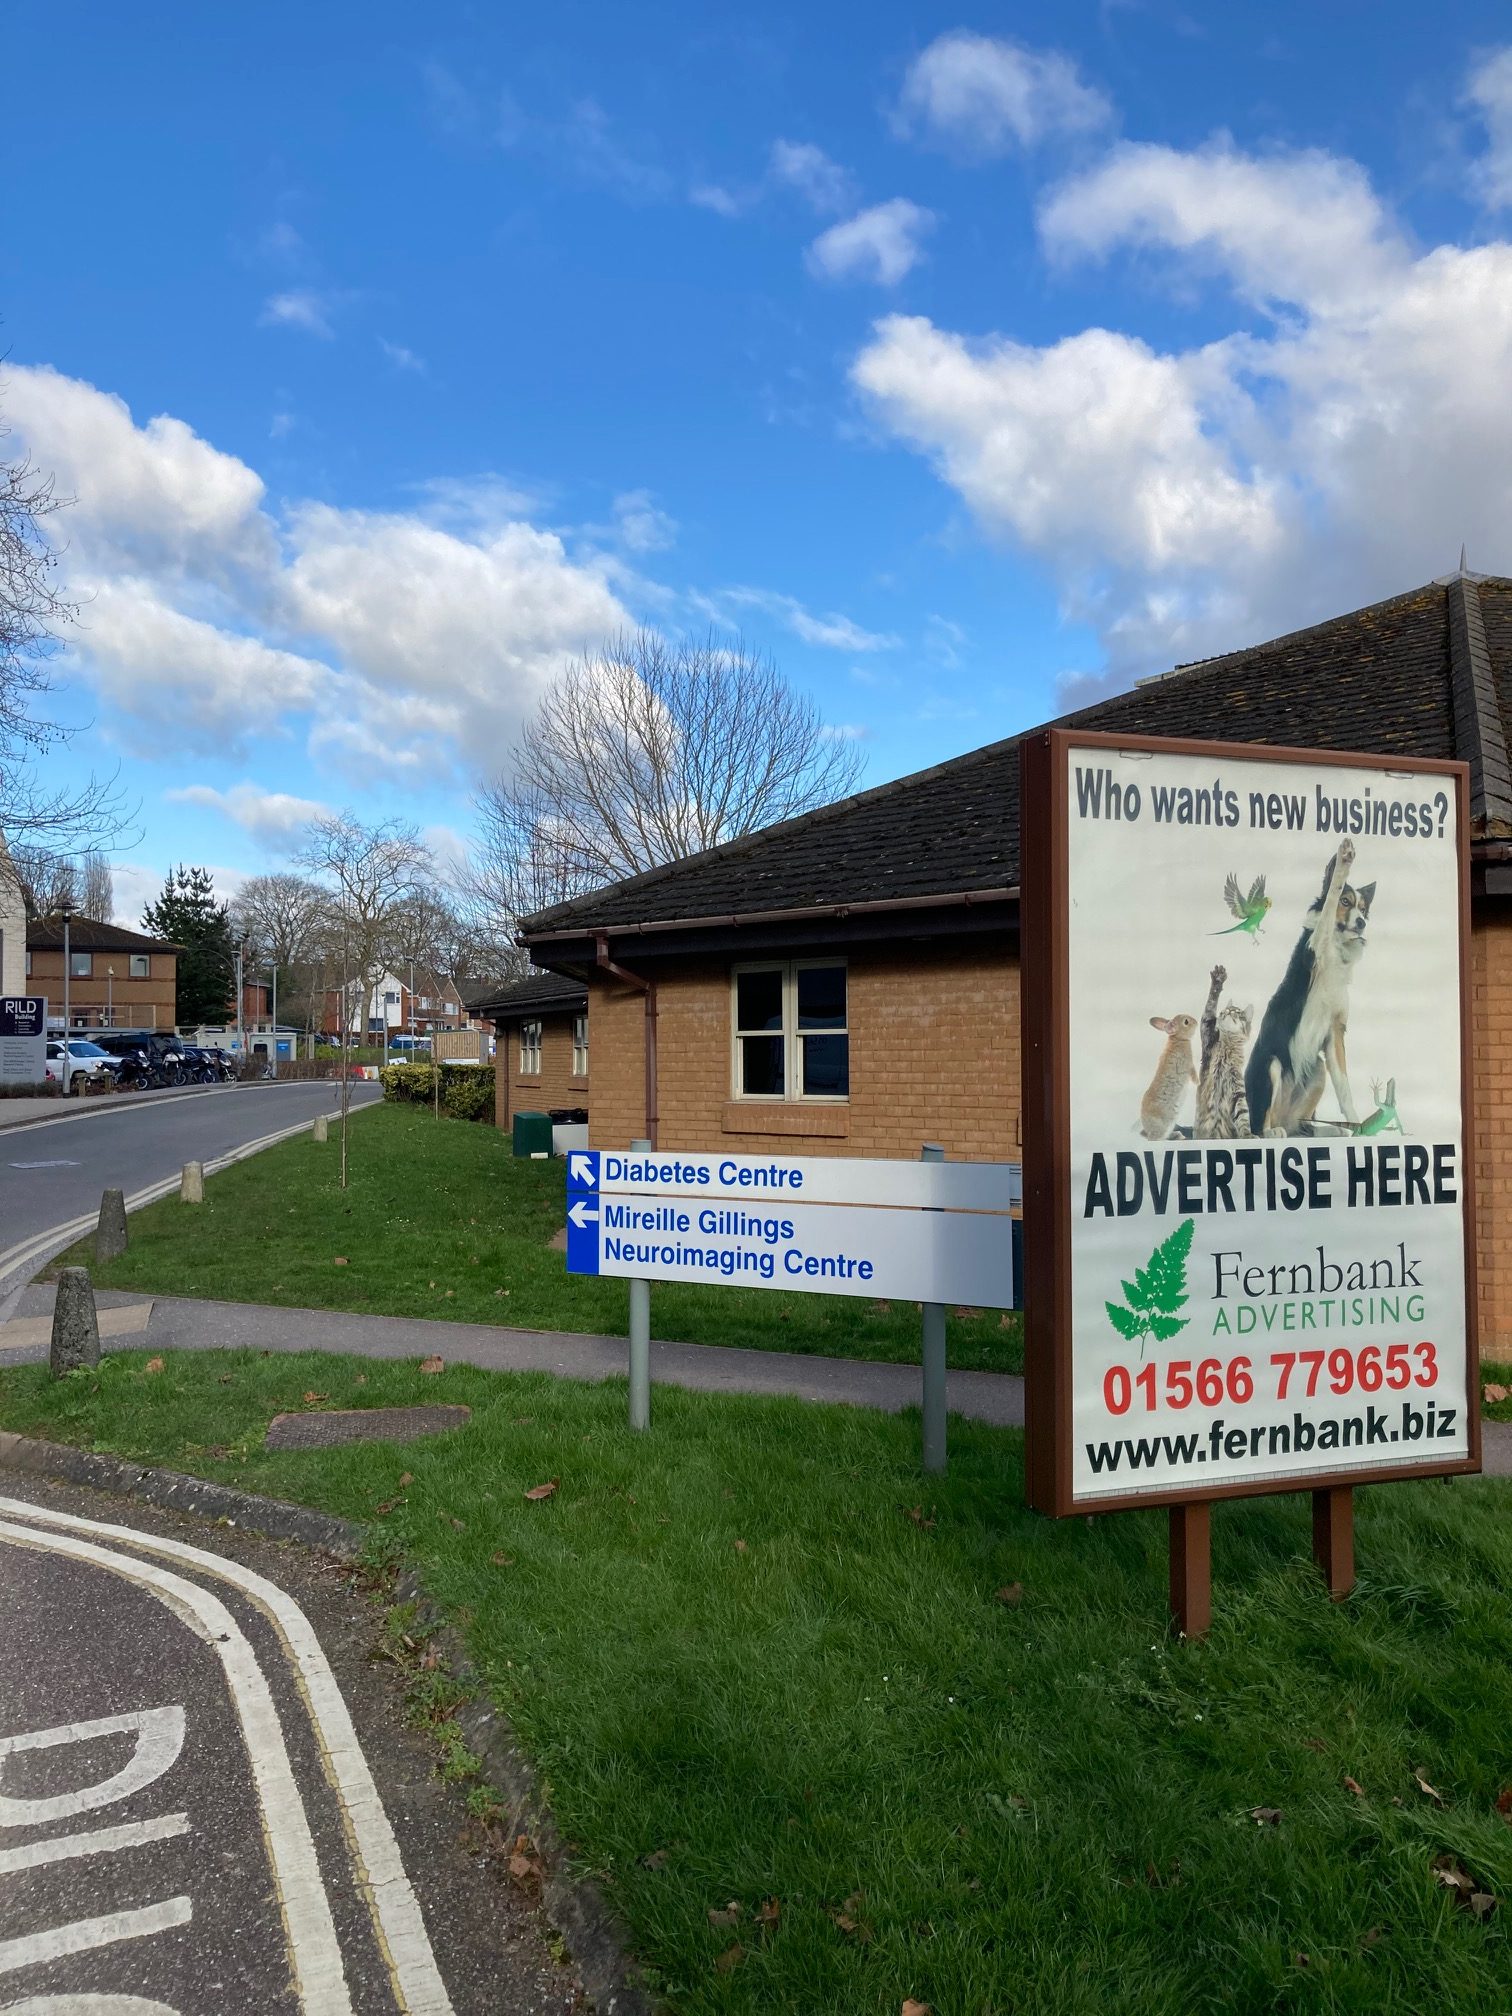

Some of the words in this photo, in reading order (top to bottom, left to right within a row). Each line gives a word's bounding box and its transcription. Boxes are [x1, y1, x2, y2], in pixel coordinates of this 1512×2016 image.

[1075, 767, 1142, 822] Who
[1150, 777, 1240, 828] wants
[1249, 792, 1307, 831] new
[1315, 784, 1449, 839] business?
[5, 1000, 37, 1014] RILD
[605, 1157, 711, 1185] Diabetes
[718, 1160, 804, 1189] Centre
[1083, 1146, 1332, 1219] ADVERTISE
[1346, 1143, 1458, 1208] HERE
[604, 1204, 691, 1234] Mireille
[698, 1209, 795, 1245] Gillings
[604, 1236, 776, 1280] Neuroimaging
[783, 1248, 875, 1281] Centre
[1210, 1242, 1425, 1300] Fernbank
[1212, 1294, 1426, 1337] ADVERTISING
[1103, 1355, 1255, 1416] 01566
[1270, 1341, 1439, 1401] 779653
[1085, 1400, 1457, 1475] www.fernbank.biz
